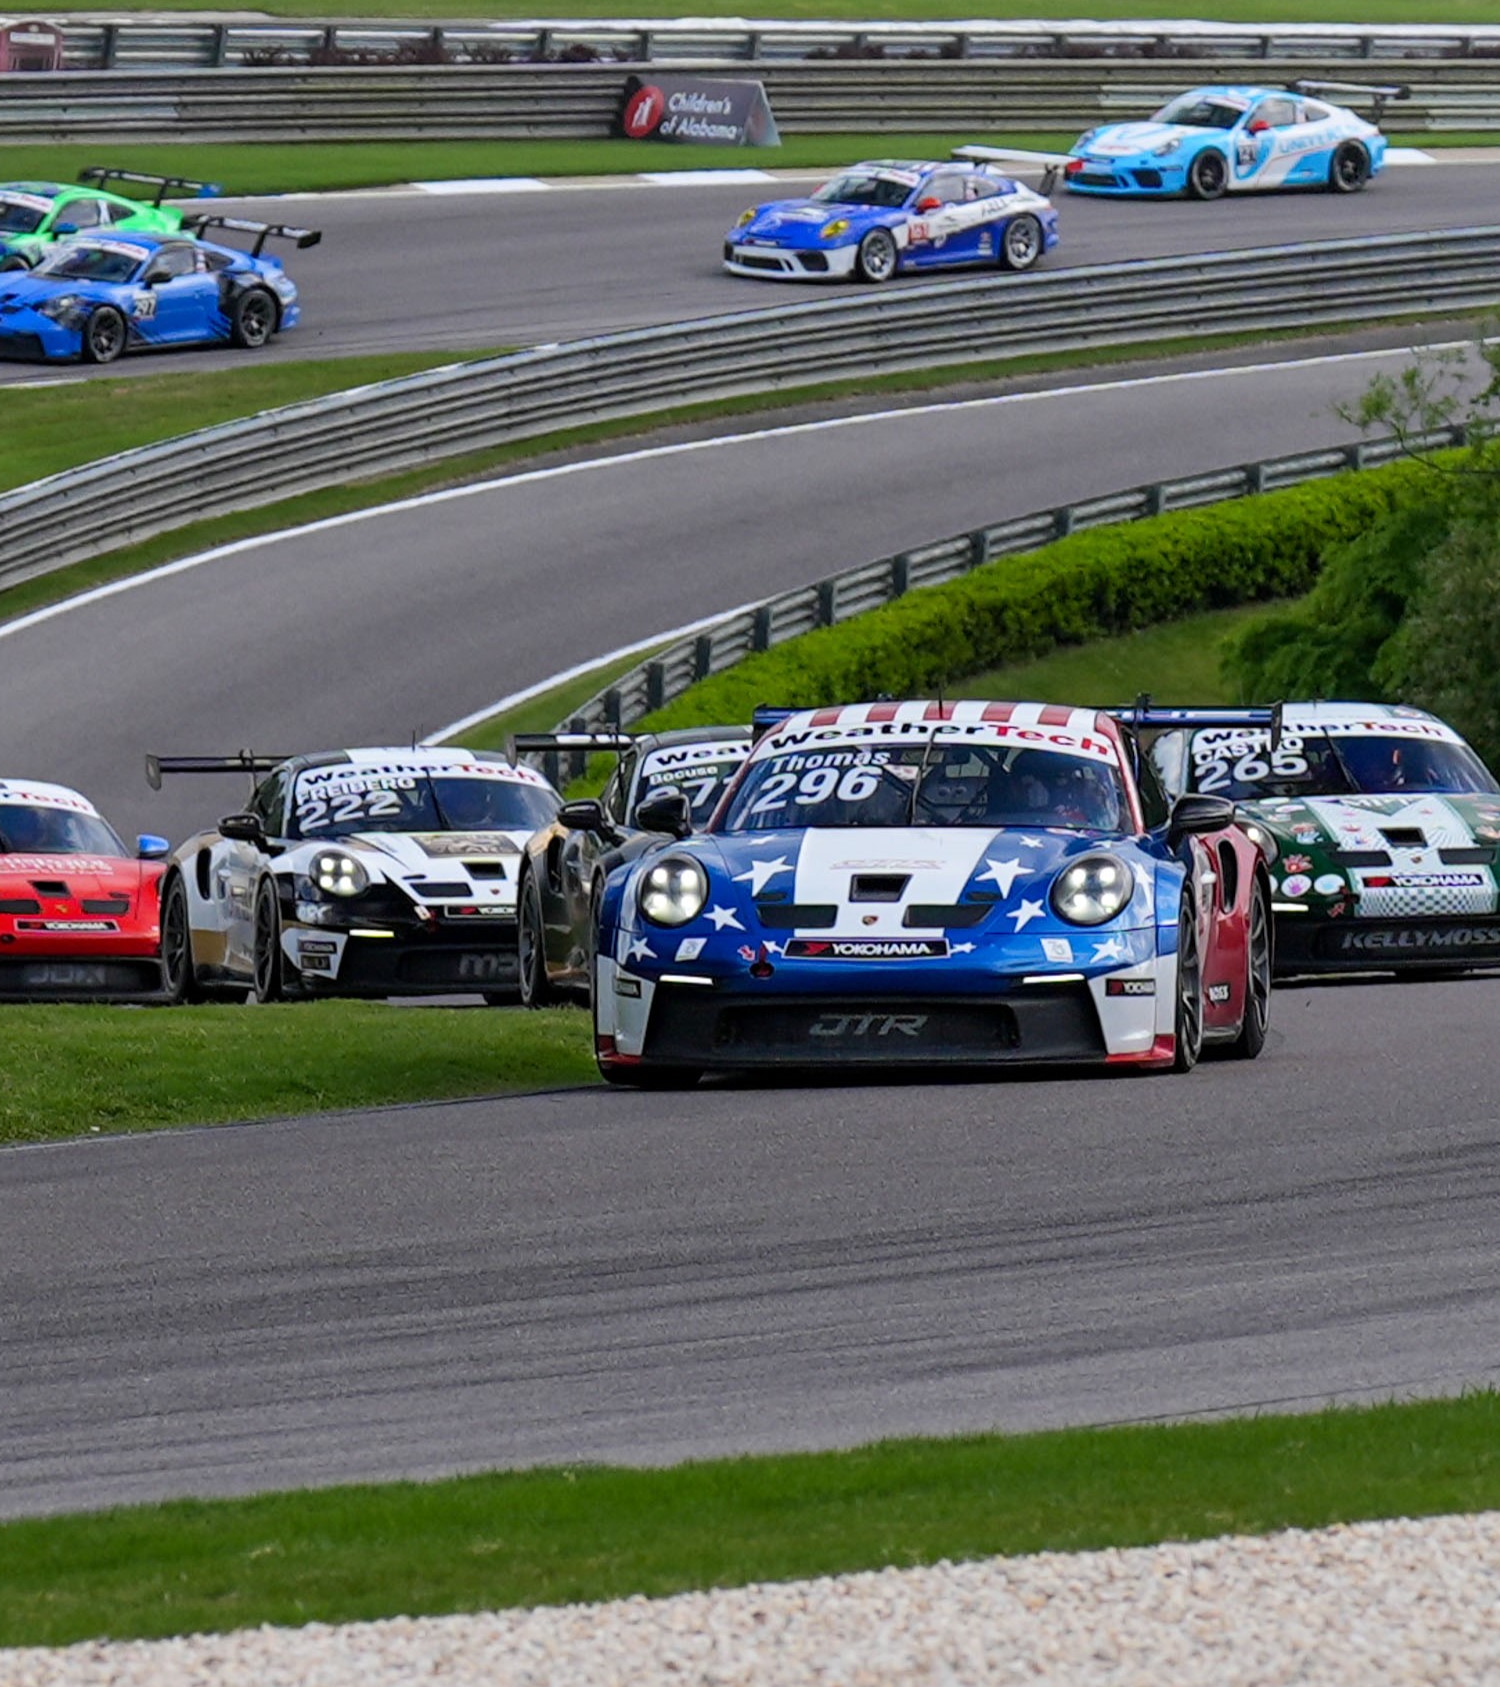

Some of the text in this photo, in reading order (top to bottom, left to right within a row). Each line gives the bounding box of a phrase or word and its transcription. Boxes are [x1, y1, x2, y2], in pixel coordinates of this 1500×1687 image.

[668, 92, 732, 114] Children's
[660, 118, 738, 140] of Alabama
[770, 721, 1109, 756] WeatherTech
[771, 748, 891, 772] Thomas
[304, 763, 538, 786] WeatherTech
[649, 765, 719, 786] Bocuse
[1193, 750, 1309, 794] 265
[298, 776, 417, 805] FREIBERG
[749, 764, 884, 814] 296
[295, 790, 401, 833] 222
[1392, 873, 1482, 888] YOKOHAMA
[44, 921, 109, 931] YOKOHAMA
[831, 941, 923, 956] YOKOHAMA
[808, 1013, 930, 1037] JTR
